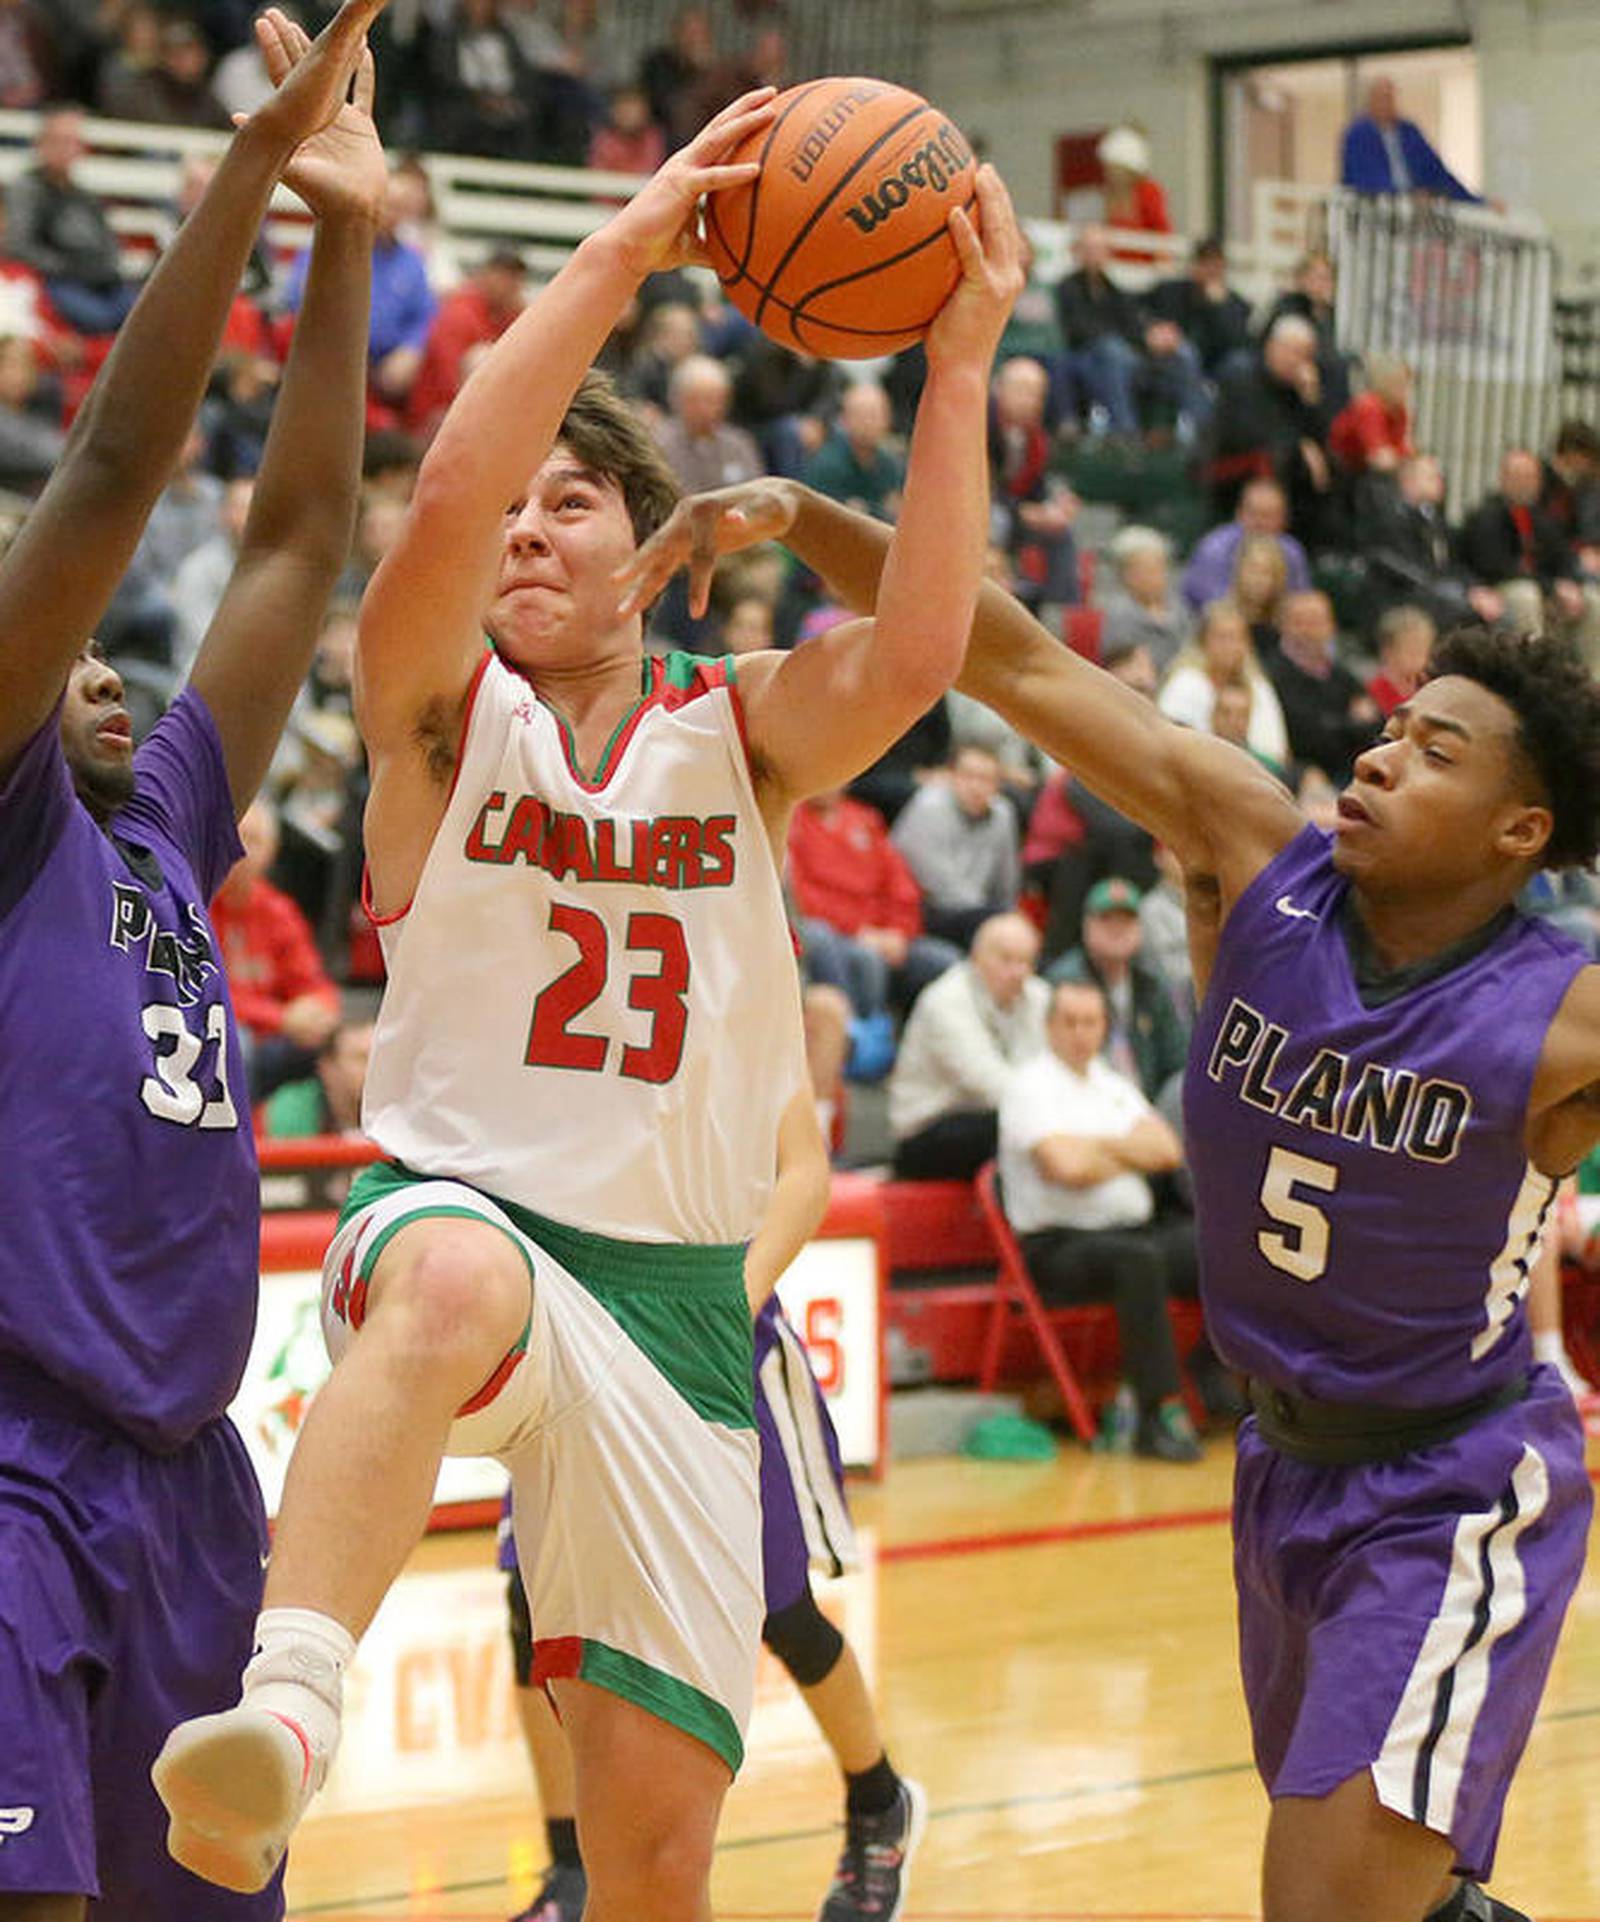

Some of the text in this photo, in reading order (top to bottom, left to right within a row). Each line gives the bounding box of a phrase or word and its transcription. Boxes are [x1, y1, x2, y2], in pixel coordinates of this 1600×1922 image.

[465, 791, 737, 890] CAVALIERS
[523, 901, 691, 1085] 23
[1207, 997, 1473, 1165] PLANO
[1256, 1145, 1339, 1283] 5
